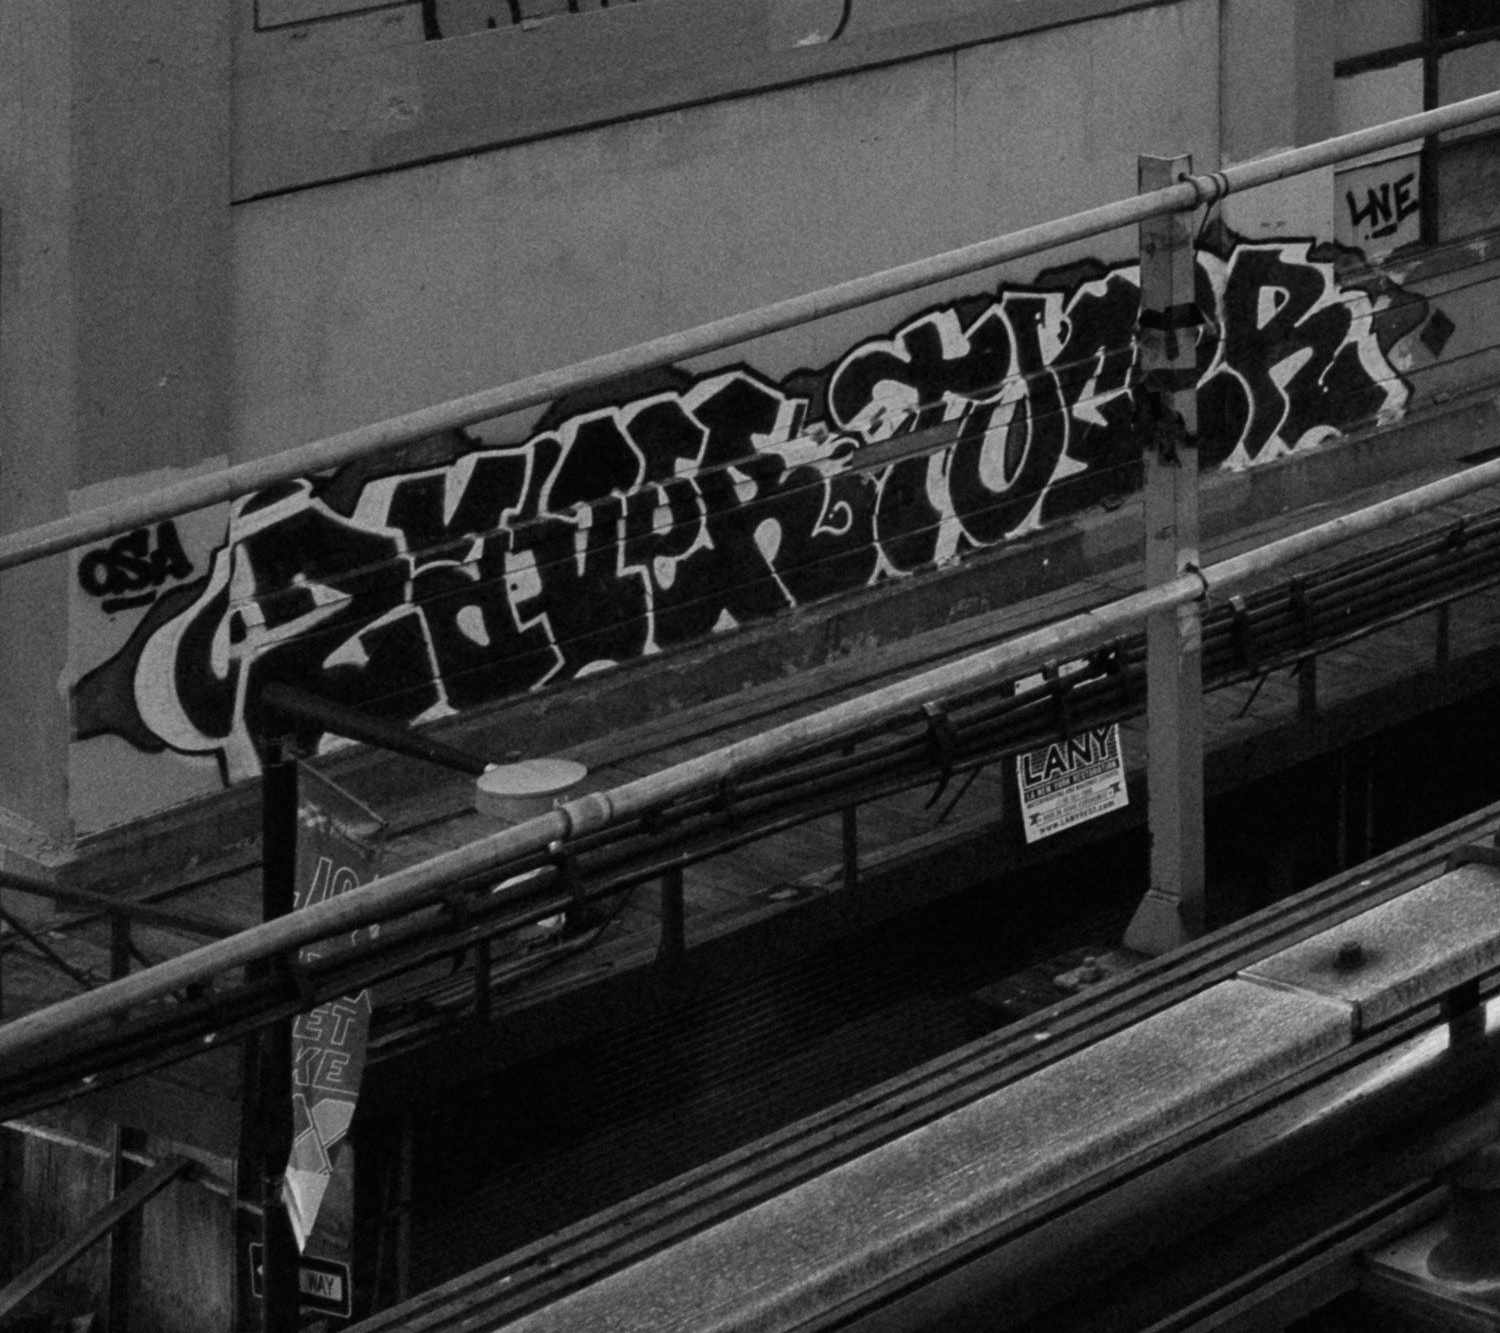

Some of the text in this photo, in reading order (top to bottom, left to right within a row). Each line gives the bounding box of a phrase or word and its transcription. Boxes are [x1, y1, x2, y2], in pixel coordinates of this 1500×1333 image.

[1346, 173, 1419, 228] LNE
[1021, 724, 1114, 789] LANY
[308, 1272, 334, 1297] WAY
